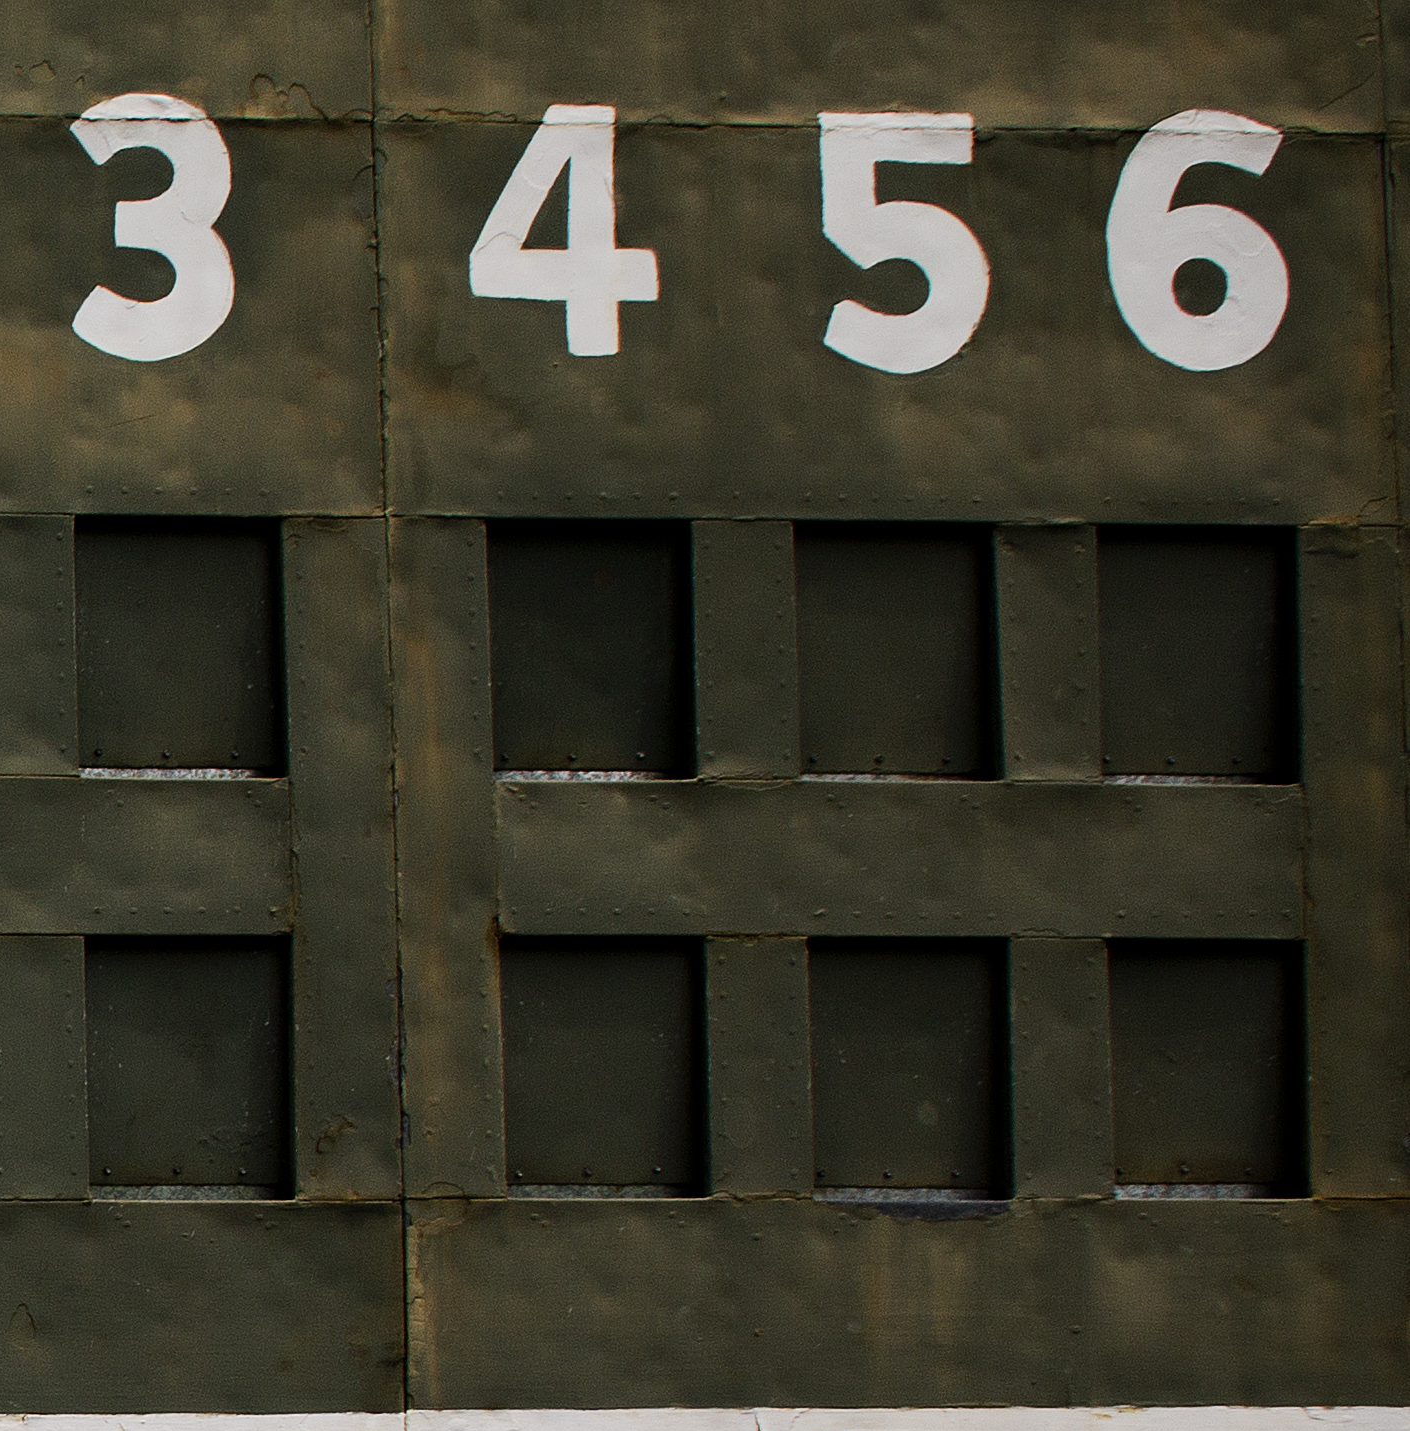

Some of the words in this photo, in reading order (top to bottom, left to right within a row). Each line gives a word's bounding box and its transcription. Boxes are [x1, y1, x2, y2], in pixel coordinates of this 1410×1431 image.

[69, 93, 234, 362] 3
[469, 104, 659, 357] 4
[817, 112, 990, 374] 5
[1106, 109, 1289, 371] 6
